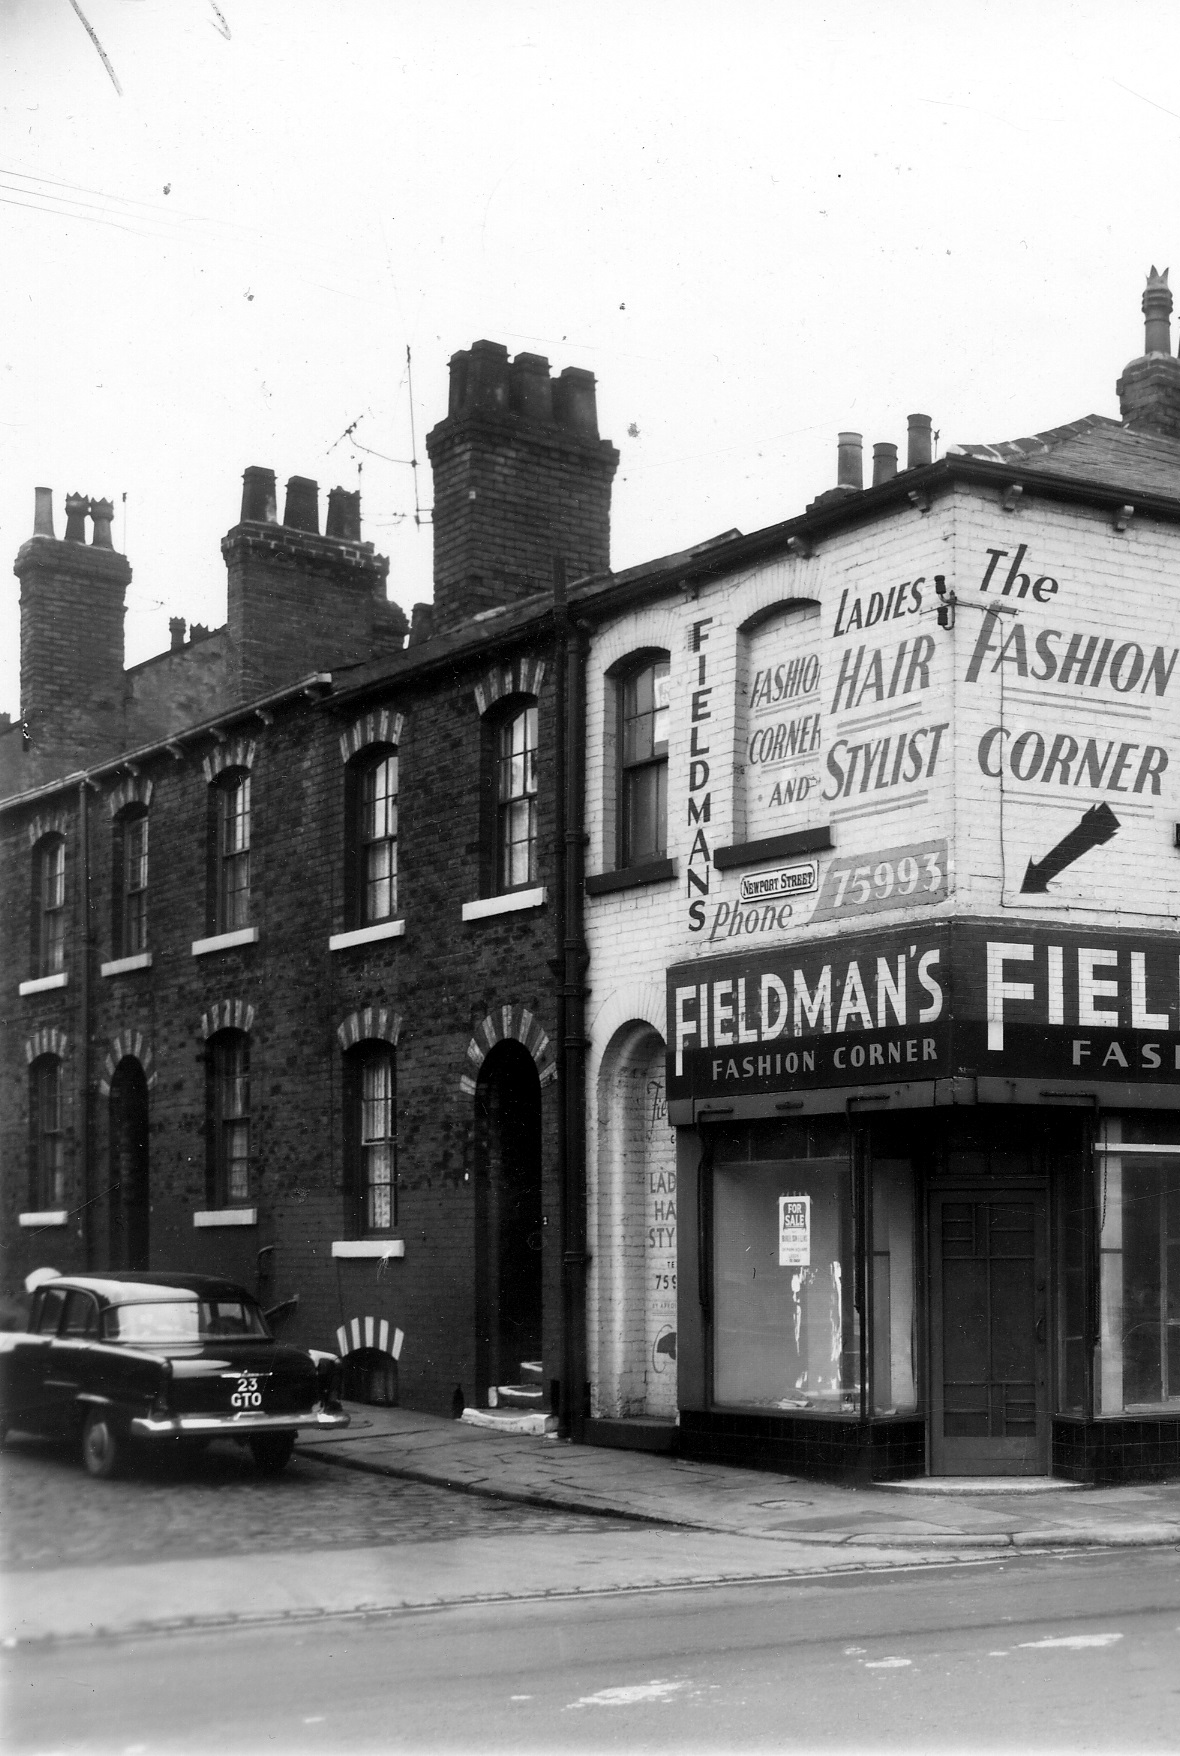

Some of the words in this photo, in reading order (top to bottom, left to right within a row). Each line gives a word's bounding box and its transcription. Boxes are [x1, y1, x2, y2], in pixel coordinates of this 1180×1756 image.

[979, 544, 1058, 603] The
[833, 578, 925, 638] LADIES
[830, 634, 936, 714] HAIR
[965, 604, 1179, 697] FASHION
[750, 654, 822, 708] FASHIO
[688, 617, 712, 931] FIELDMANS
[822, 723, 949, 801] STYLIST
[978, 726, 1169, 795] CORNER
[769, 776, 810, 807] AND
[743, 878, 779, 896] NEWPORT
[780, 872, 812, 889] STREET
[833, 852, 942, 908] 75993
[710, 900, 793, 939] Phone
[675, 945, 943, 1076] FIELDMAN'S
[712, 1050, 816, 1081] FASHION
[833, 1037, 938, 1069] CORNER
[655, 1200, 677, 1220] HA
[785, 1214, 805, 1226] SALE
[787, 1203, 802, 1213] FOR
[649, 1227, 675, 1248] STY
[231, 1392, 262, 1408] GTO
[237, 1378, 258, 1392] 23
